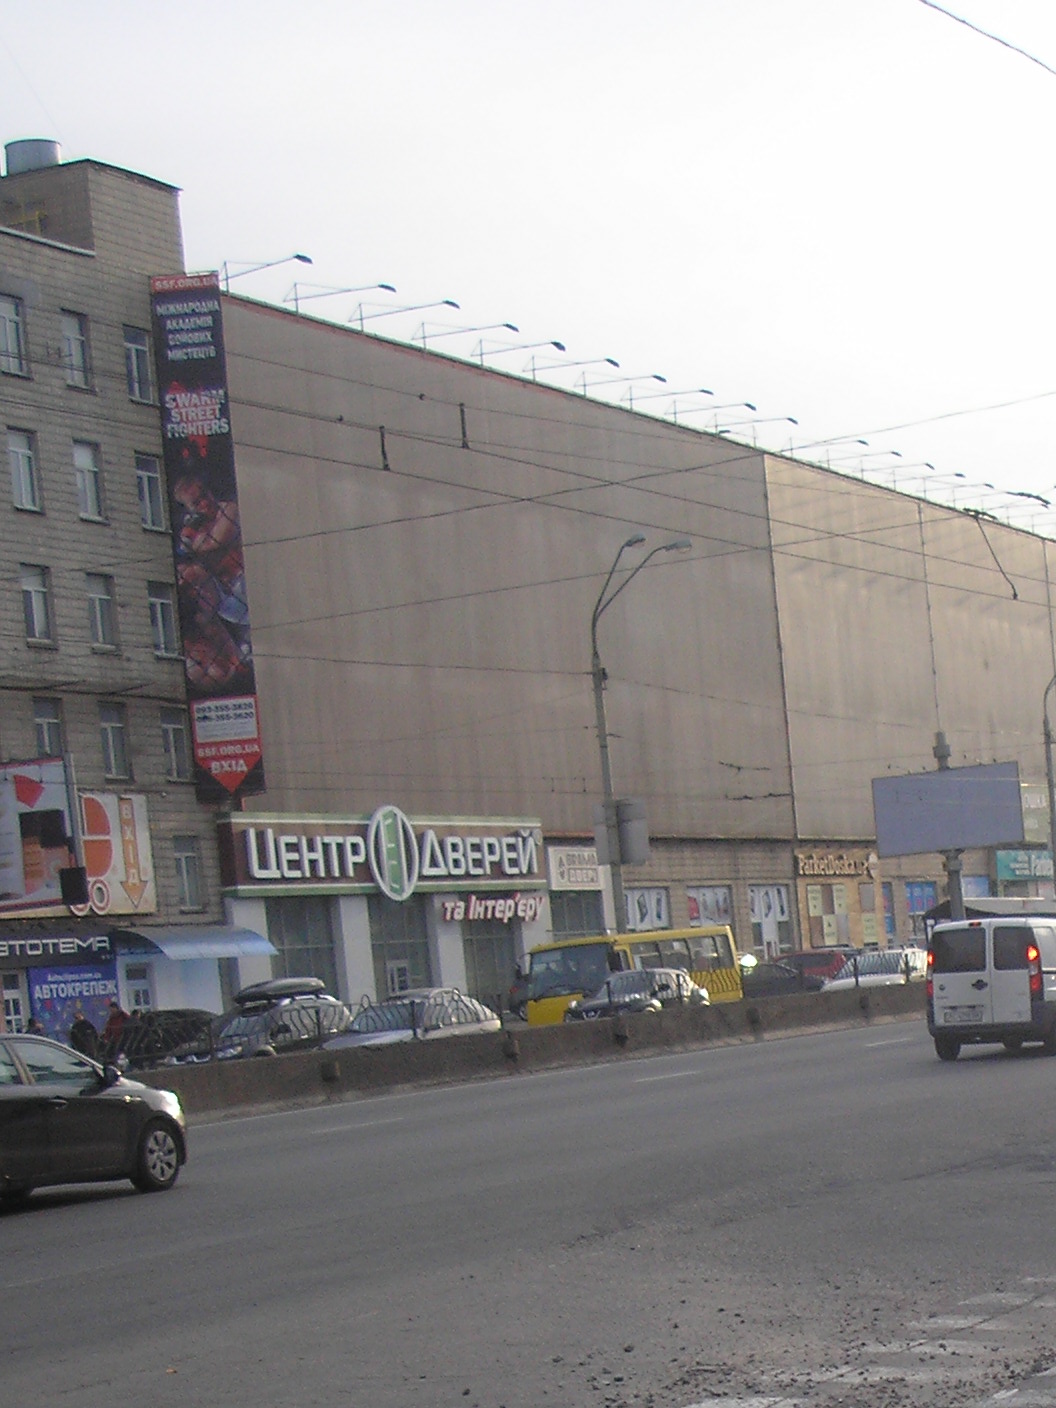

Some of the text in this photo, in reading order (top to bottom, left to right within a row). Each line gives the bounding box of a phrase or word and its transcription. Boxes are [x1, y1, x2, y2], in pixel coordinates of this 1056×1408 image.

[166, 315, 213, 330] АКАДЕМІЯ
[165, 389, 225, 409] SWARM
[171, 404, 221, 423] STREET
[167, 418, 229, 438] FIGHTERS
[211, 759, 248, 774] ВХІД
[246, 828, 538, 879] ЦЕНТР ДВЕРЕЙ
[443, 902, 465, 921] та
[34, 980, 118, 1000] АВТОКРЕПЕЖ
